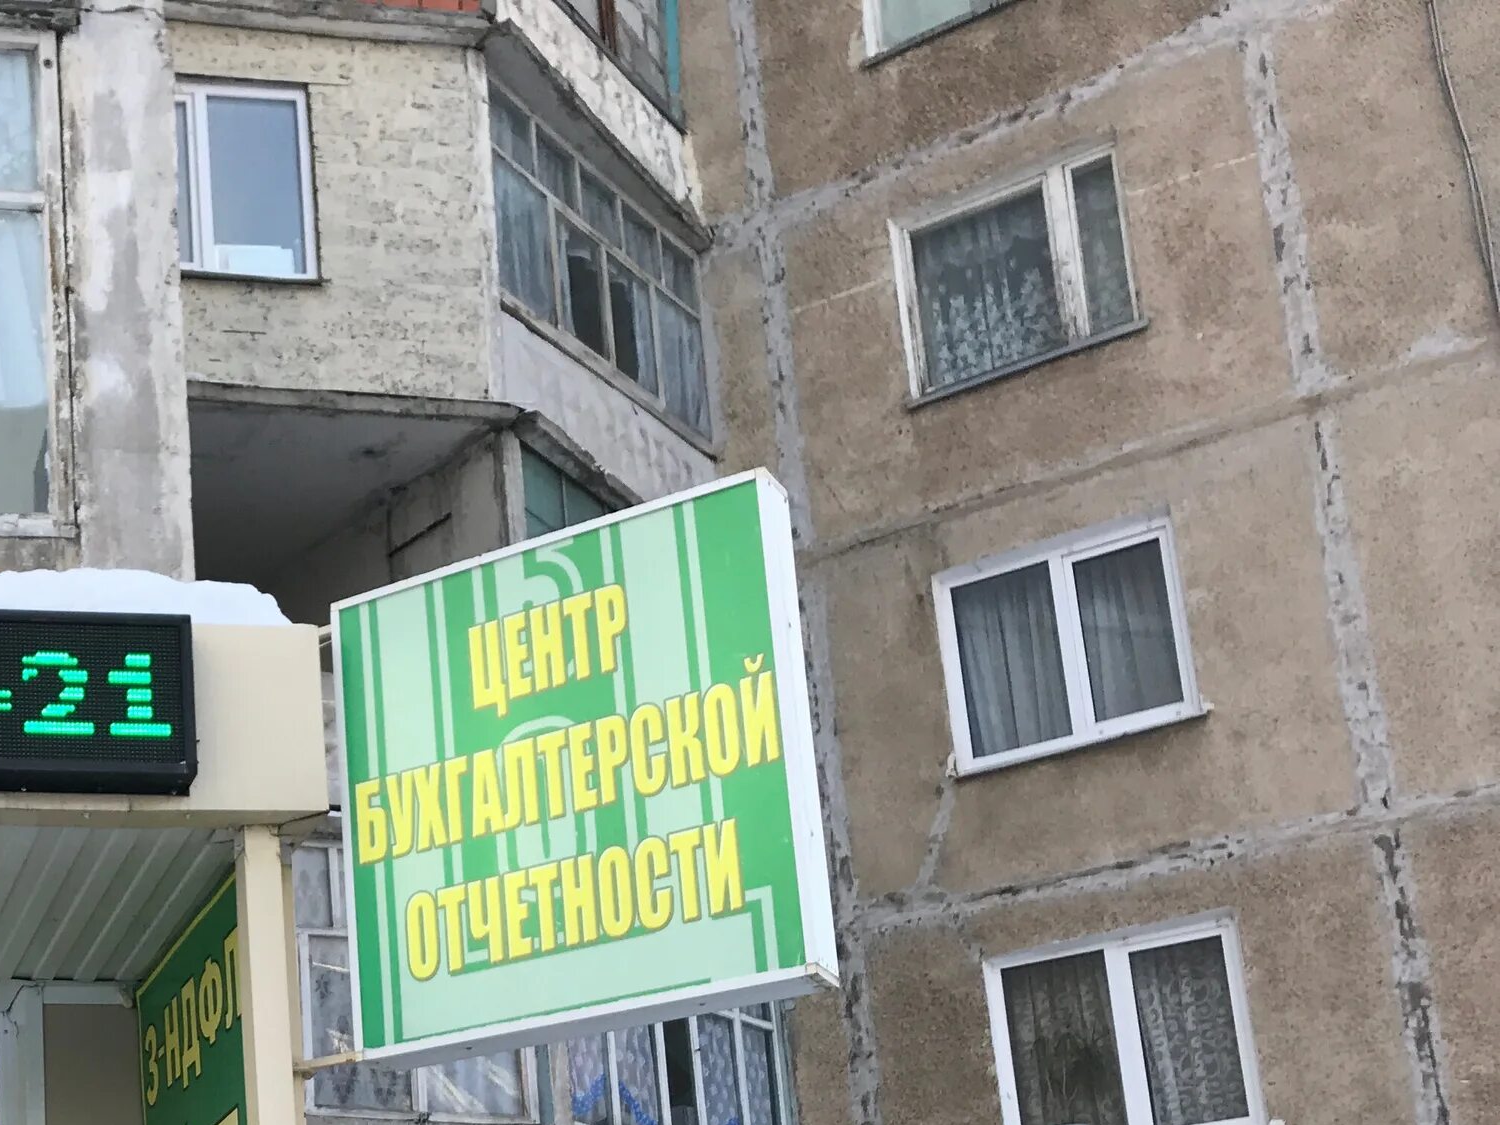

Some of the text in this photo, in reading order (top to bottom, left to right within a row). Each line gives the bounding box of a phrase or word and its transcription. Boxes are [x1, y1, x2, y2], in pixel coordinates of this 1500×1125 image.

[468, 582, 628, 719] ЦЕНТР
[354, 652, 781, 866] БУХГАЛТЕРСКОЙ
[404, 817, 745, 982] ОТЧЕТНОСТИ
